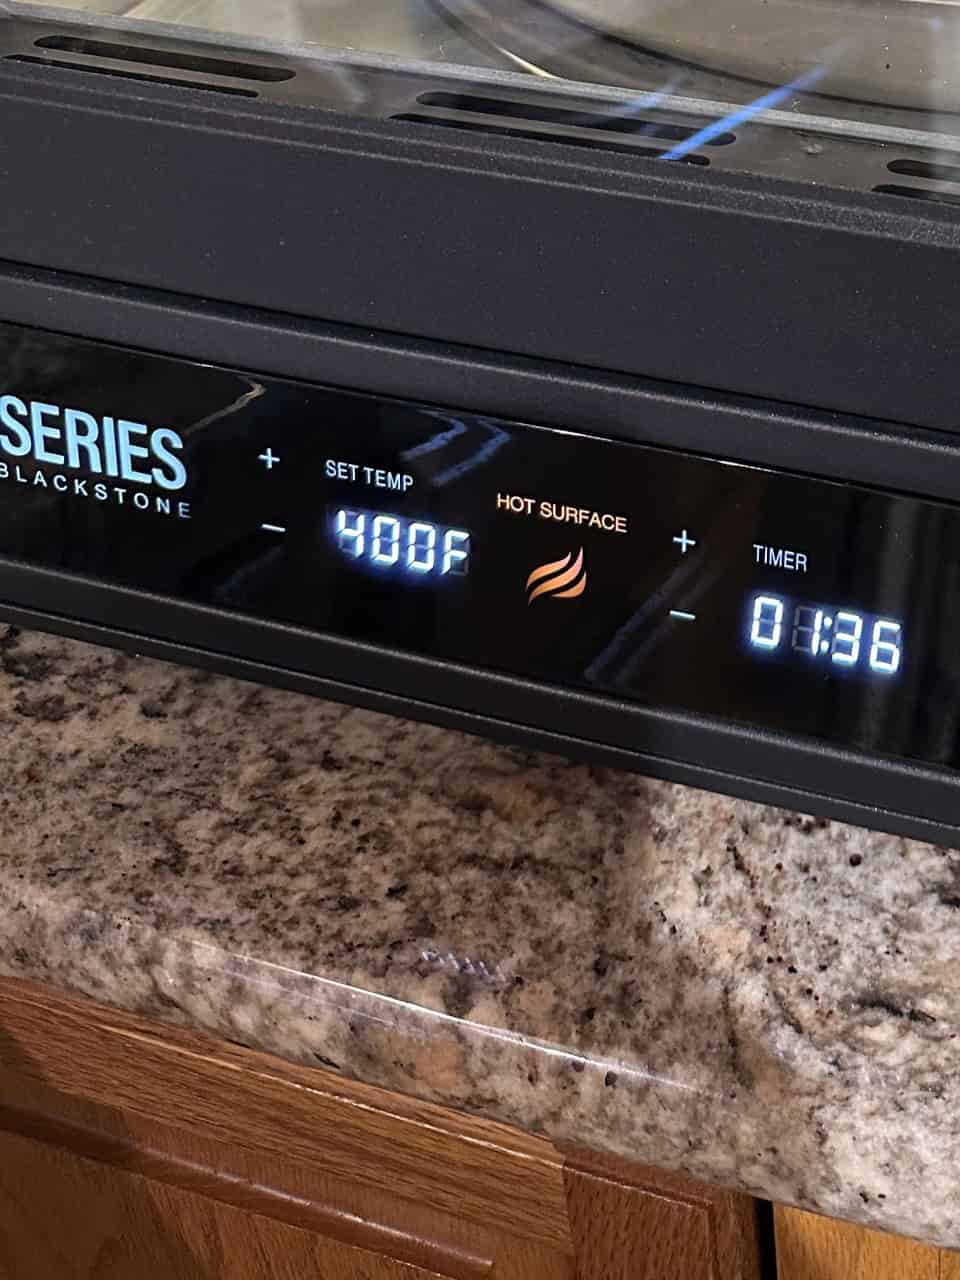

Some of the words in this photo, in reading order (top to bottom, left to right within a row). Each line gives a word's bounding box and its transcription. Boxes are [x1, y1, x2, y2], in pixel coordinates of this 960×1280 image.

[0, 394, 188, 491] SERIES
[325, 459, 359, 481] SET
[363, 467, 414, 492] TEMP
[496, 493, 536, 515] HOT
[539, 502, 628, 533] SURFACE
[334, 509, 471, 576] 400F
[753, 543, 808, 573] TIMER
[750, 595, 901, 675] 01:36
